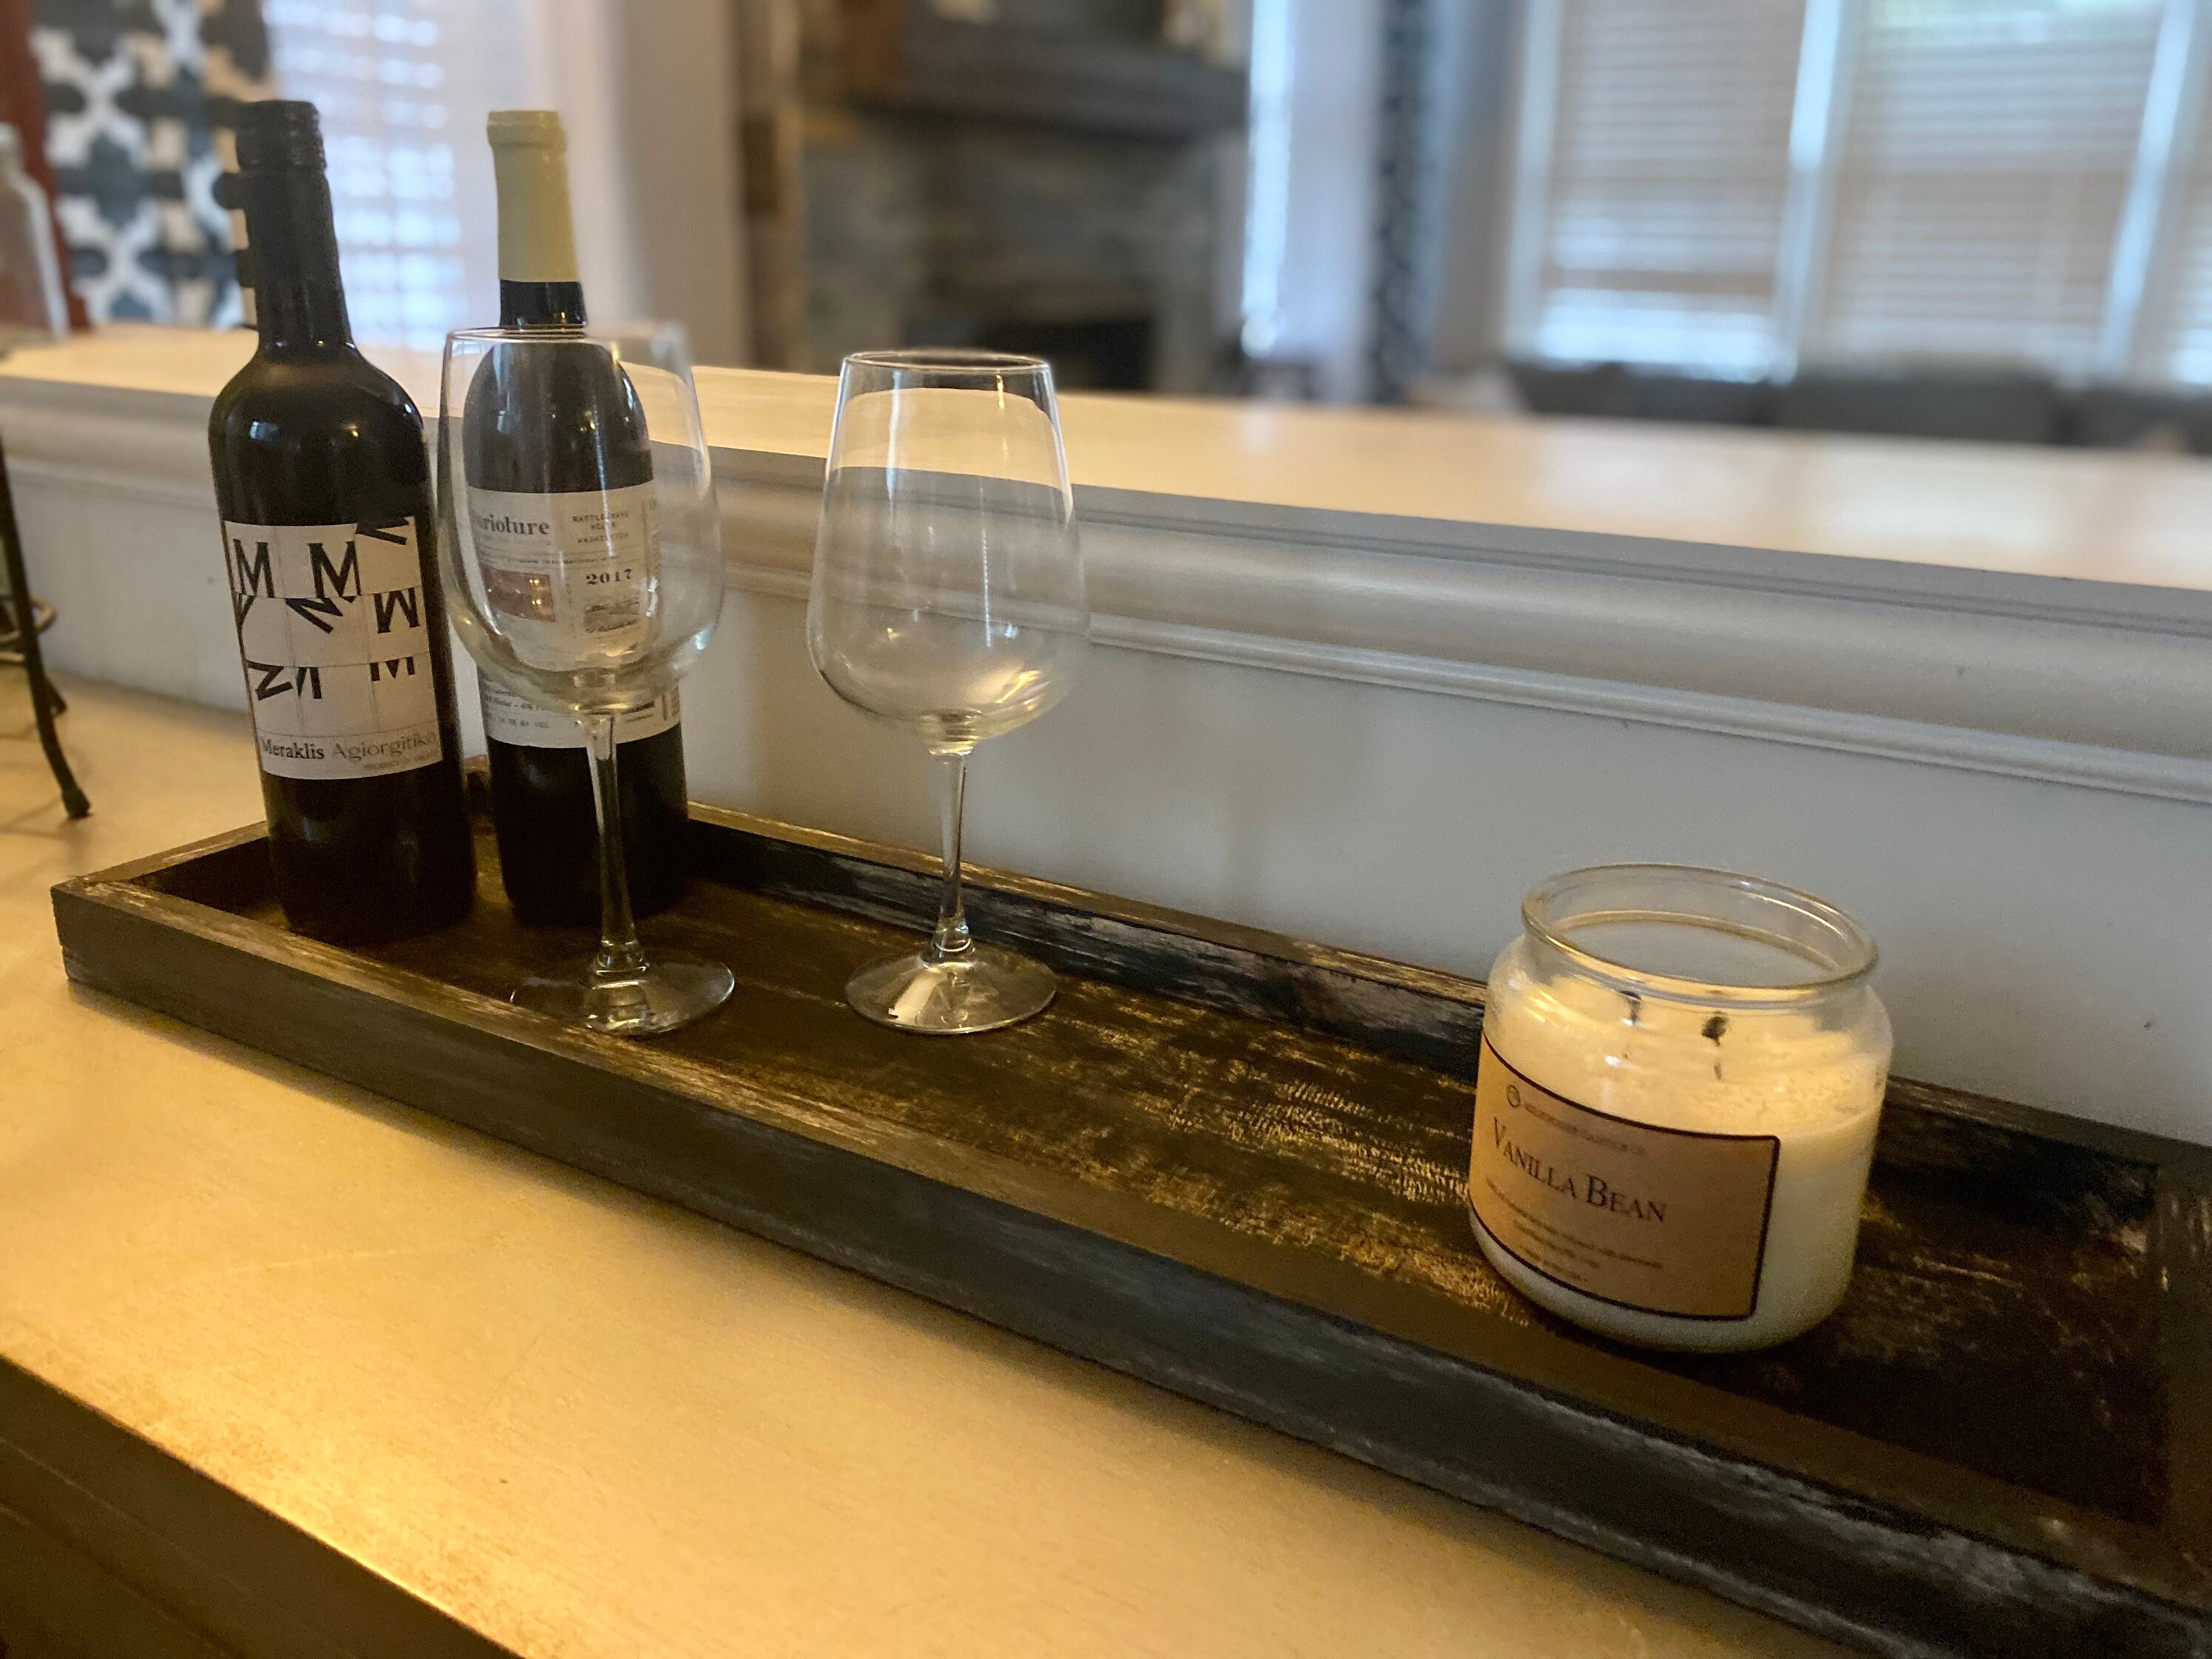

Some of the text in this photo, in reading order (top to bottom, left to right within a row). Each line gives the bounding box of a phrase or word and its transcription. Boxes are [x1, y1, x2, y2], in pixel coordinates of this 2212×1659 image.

[586, 568, 633, 586] 2017
[261, 737, 325, 760] Meraklis
[333, 732, 436, 763] Agiorgitiko
[1493, 1116, 1577, 1198] VANILLA
[1585, 1174, 1667, 1224] BEAN
